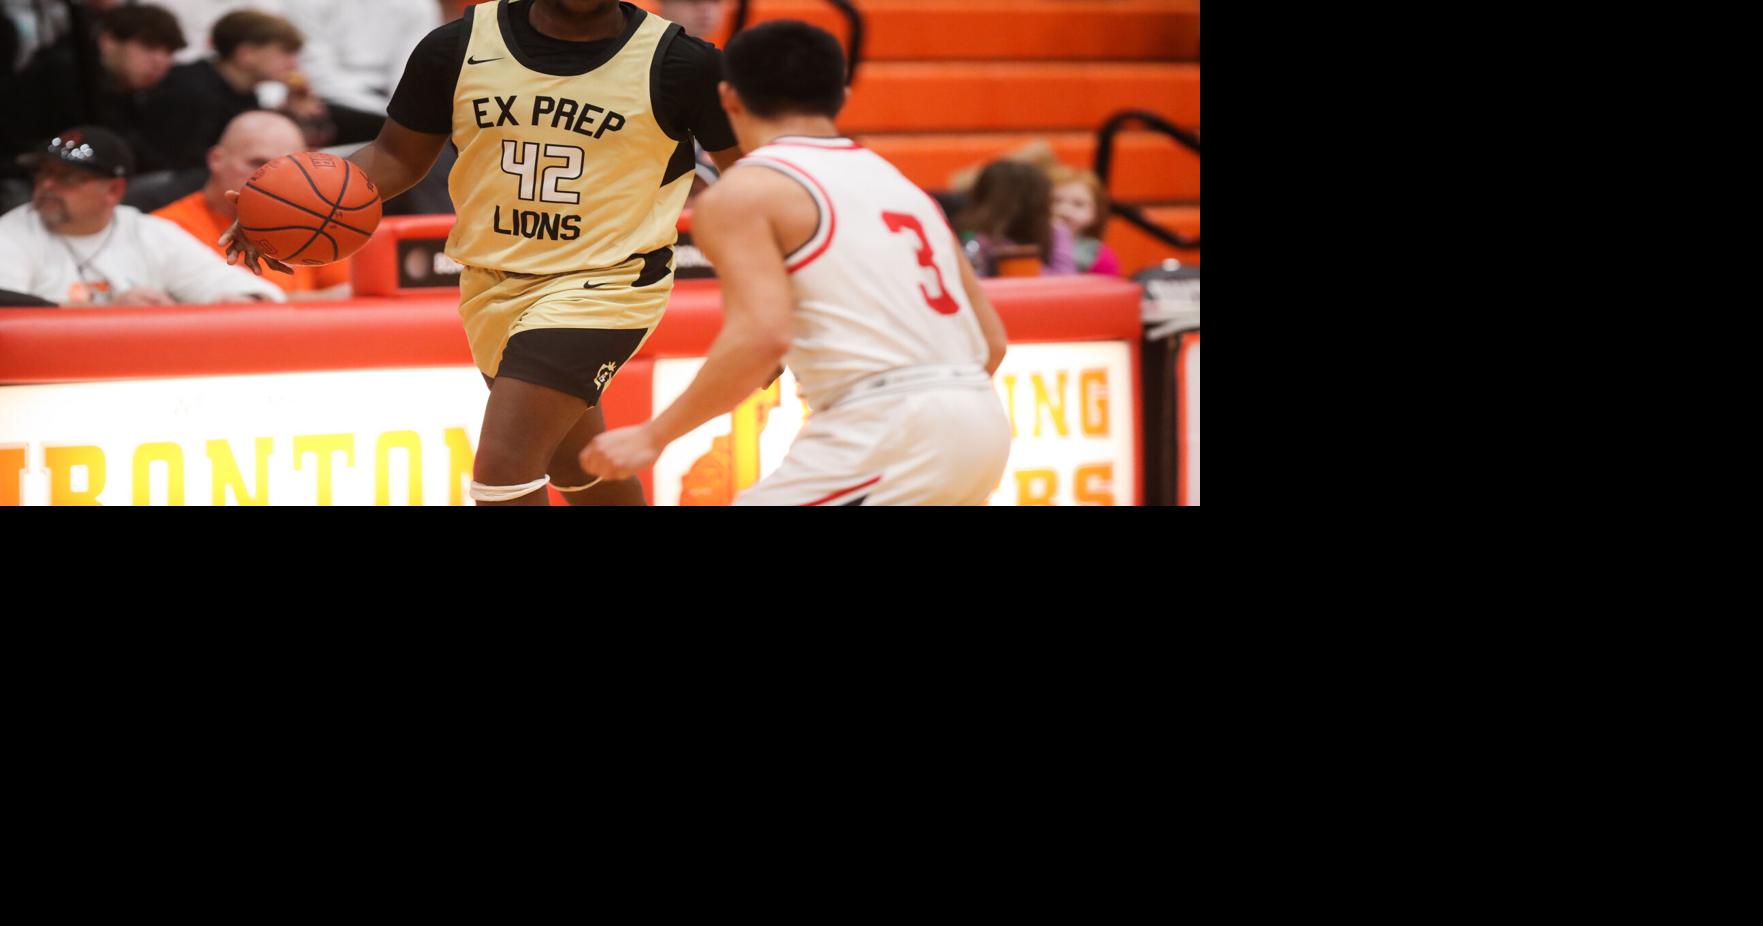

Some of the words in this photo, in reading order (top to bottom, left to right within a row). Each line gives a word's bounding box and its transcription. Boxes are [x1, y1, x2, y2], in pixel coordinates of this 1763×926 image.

[472, 95, 519, 129] EX
[531, 95, 626, 140] PREP
[501, 139, 585, 205] 42
[493, 204, 582, 241] LIONS
[881, 210, 960, 316] 3
[1002, 366, 1110, 438] ING
